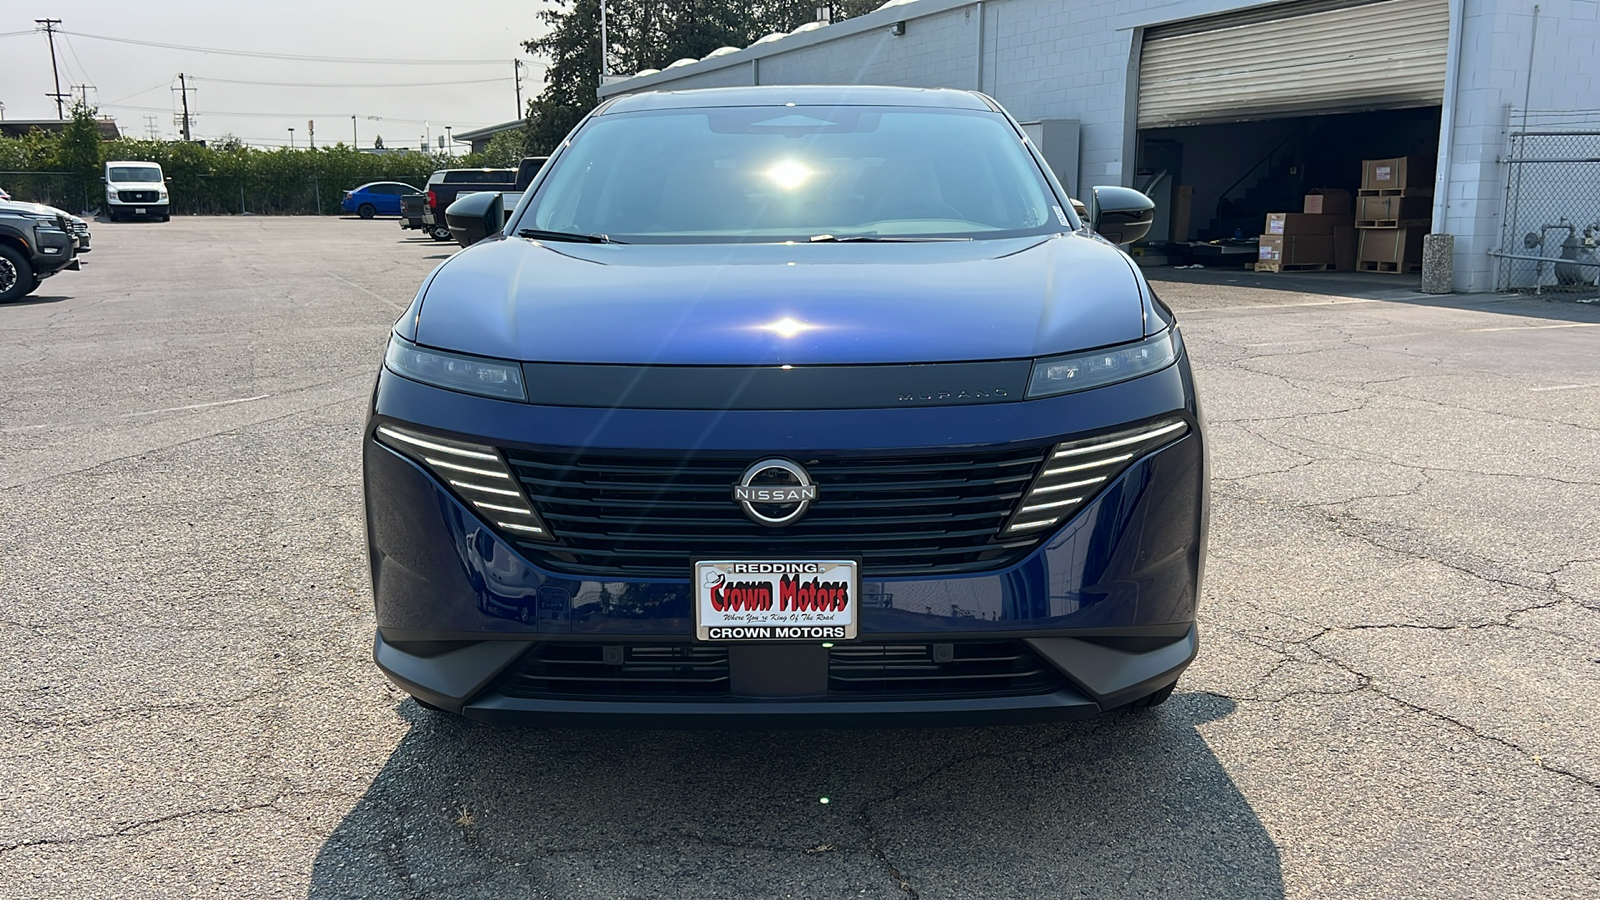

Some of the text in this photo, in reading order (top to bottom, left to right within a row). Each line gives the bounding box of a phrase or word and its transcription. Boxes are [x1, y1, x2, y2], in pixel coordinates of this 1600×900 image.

[898, 388, 1008, 401] MURANO
[736, 488, 814, 500] NISSAN
[735, 563, 818, 573] REDDING
[710, 573, 849, 612] Crown Motors
[723, 613, 836, 624] Where You're King Of The Road
[709, 627, 845, 638] CROWN MOTORS
